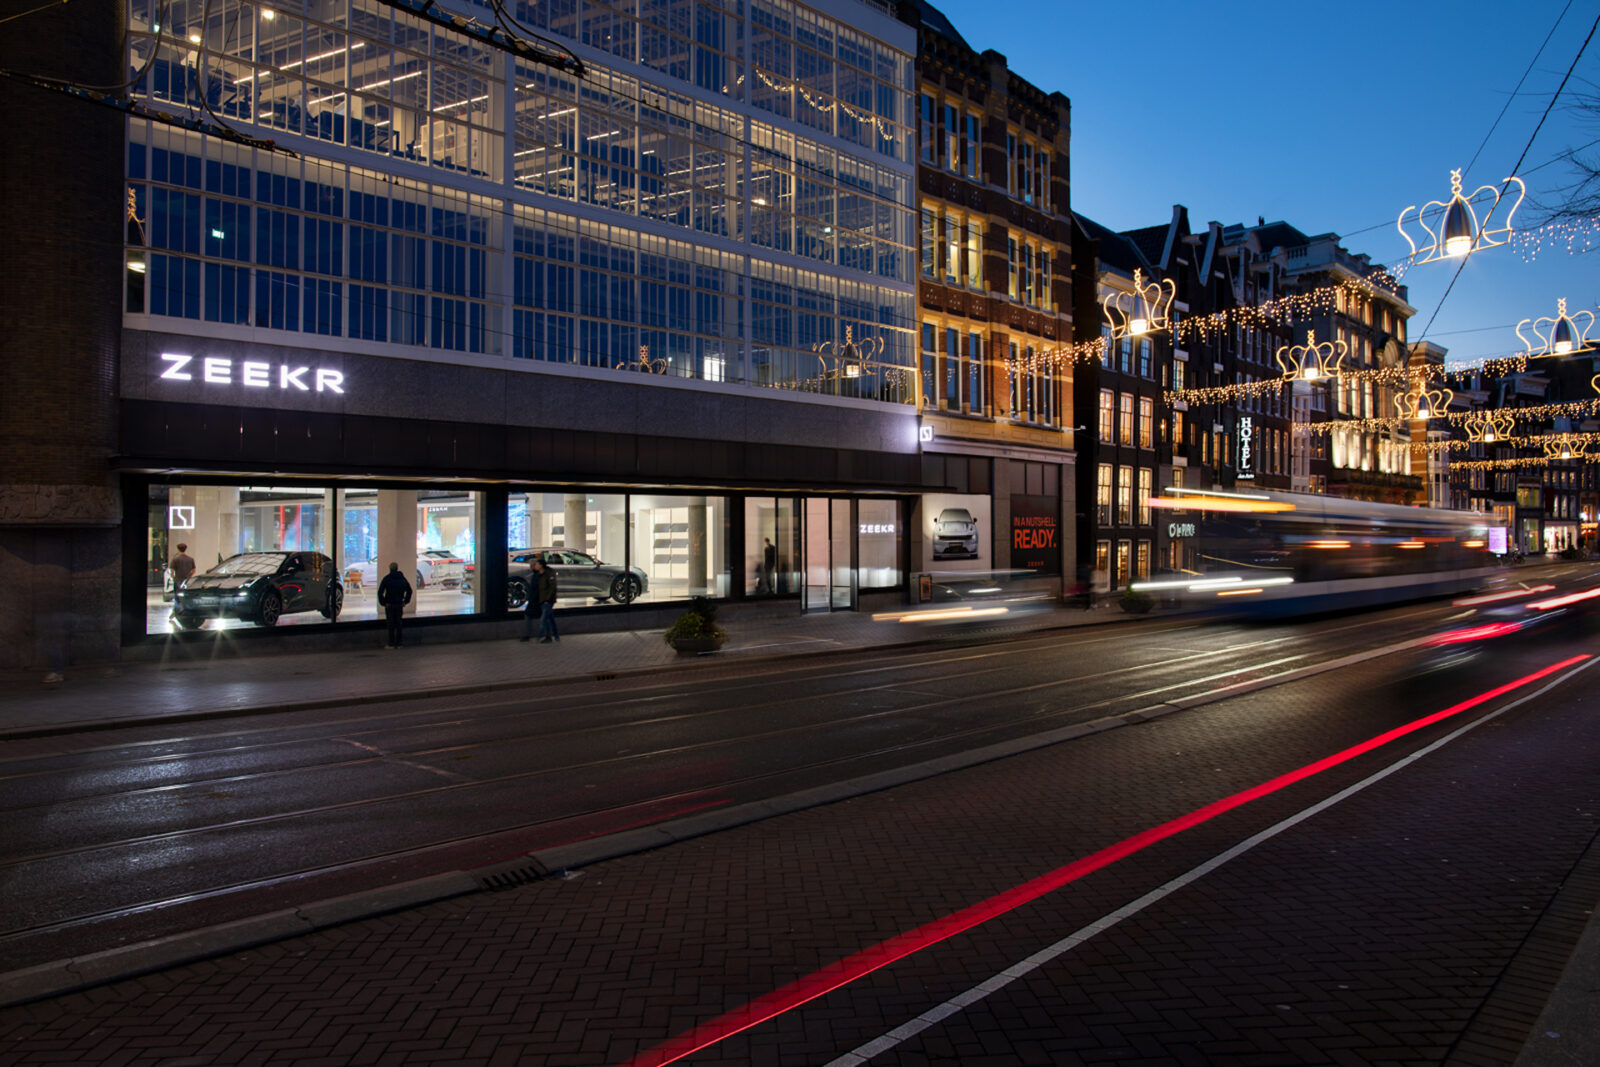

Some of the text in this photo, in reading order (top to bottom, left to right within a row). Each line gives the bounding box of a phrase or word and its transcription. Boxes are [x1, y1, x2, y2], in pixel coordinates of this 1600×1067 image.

[160, 352, 346, 395] ZEEKR
[1240, 417, 1252, 469] HOTEL
[860, 524, 895, 533] ZEEKR
[1014, 529, 1057, 549] READY.
